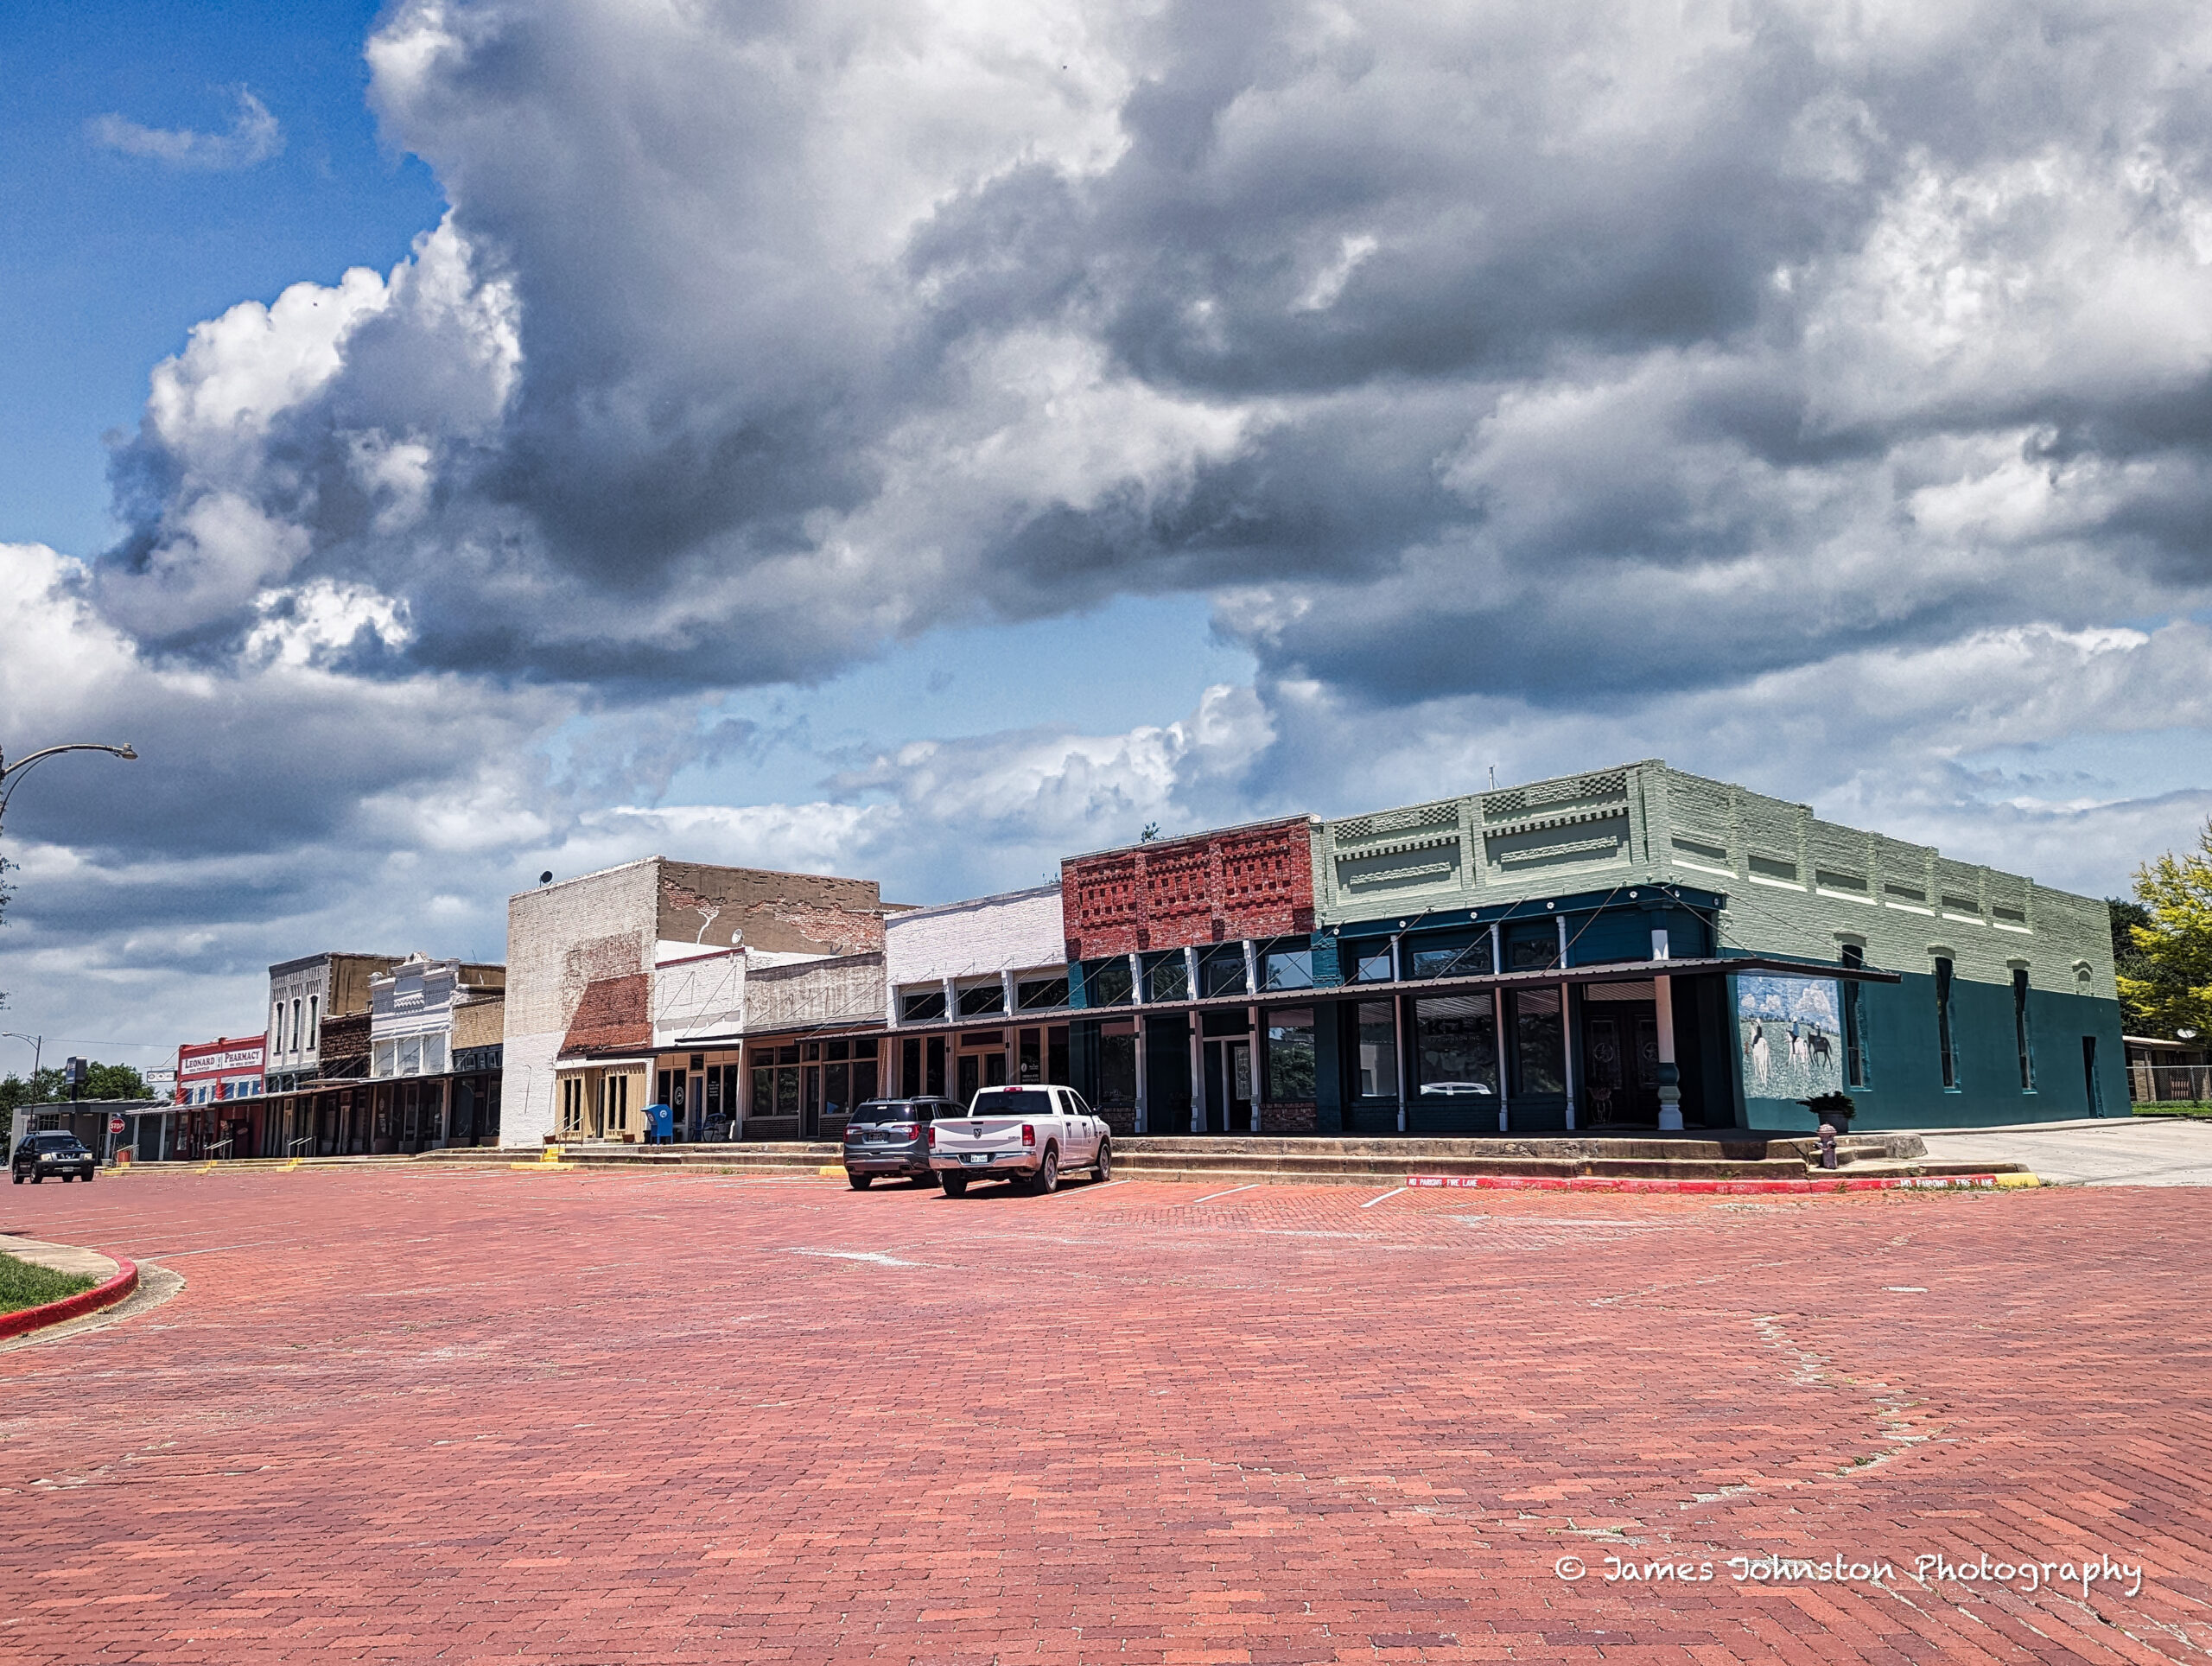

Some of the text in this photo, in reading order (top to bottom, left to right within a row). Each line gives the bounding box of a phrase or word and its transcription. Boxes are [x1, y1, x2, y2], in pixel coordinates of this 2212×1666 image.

[185, 1057, 215, 1069] LEONARD
[225, 1051, 260, 1063] PHARMACY
[1420, 1178, 1442, 1186] PARKING
[1462, 1179, 1478, 1187] LANE
